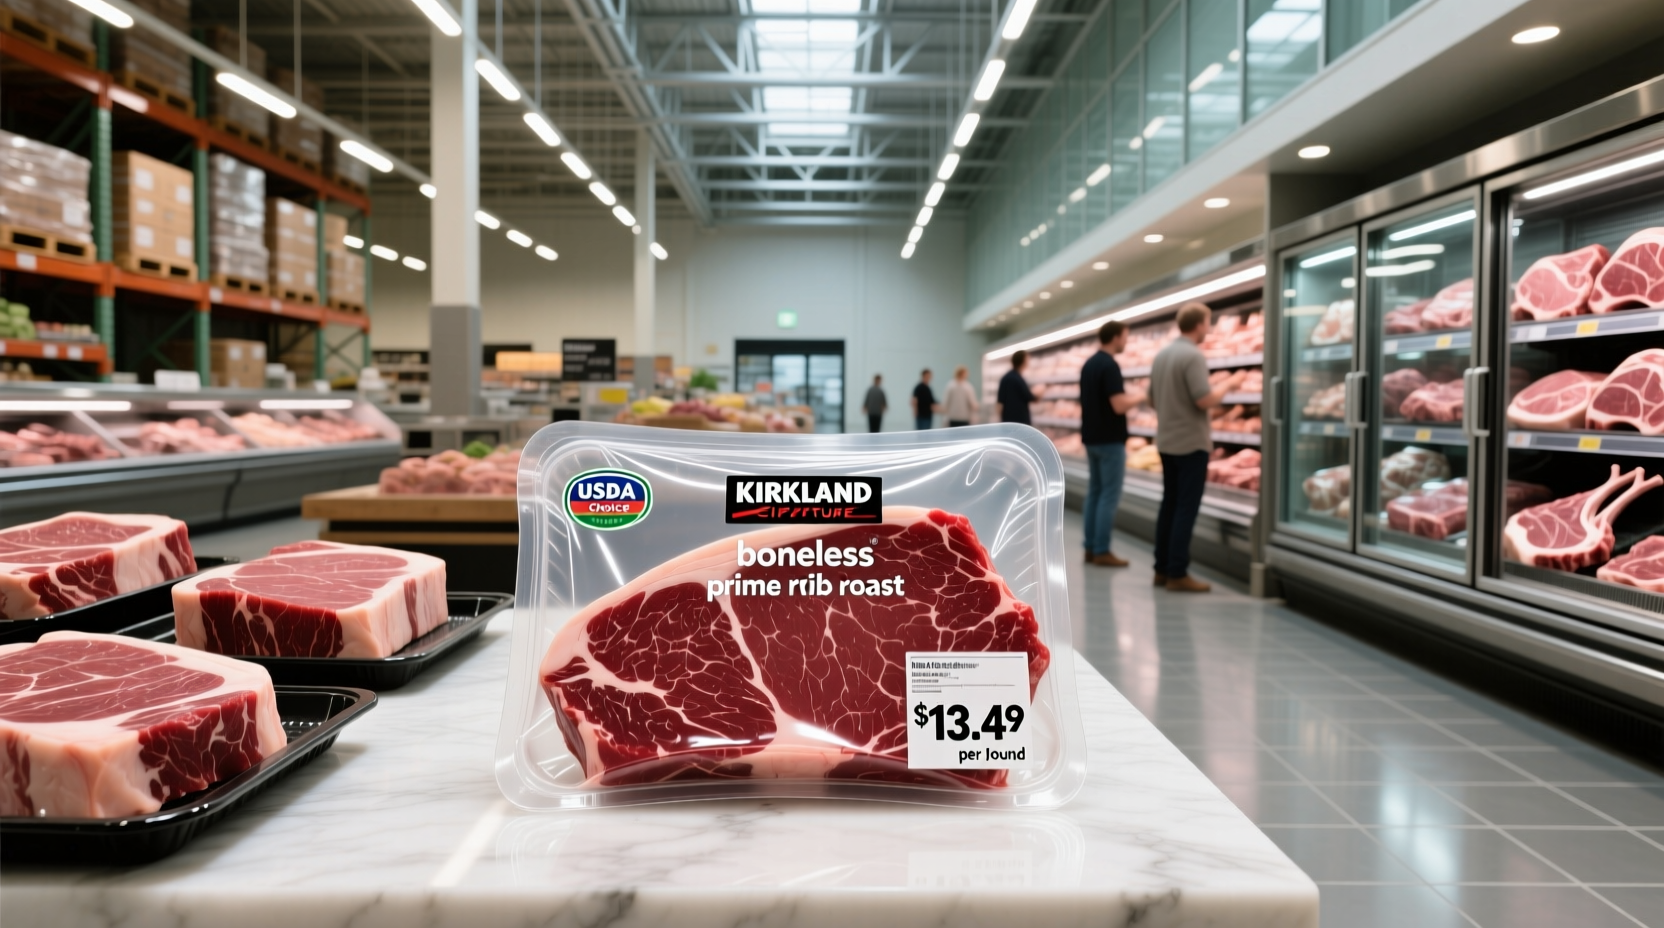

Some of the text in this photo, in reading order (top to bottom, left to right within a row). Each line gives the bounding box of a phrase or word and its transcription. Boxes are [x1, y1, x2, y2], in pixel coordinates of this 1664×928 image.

[578, 482, 636, 500] USDA
[736, 481, 872, 504] KIRKLAND
[737, 539, 874, 567] boneless
[707, 573, 781, 602] prime
[839, 575, 905, 596] roast
[913, 701, 1025, 741] $13.49
[959, 750, 981, 764] per
